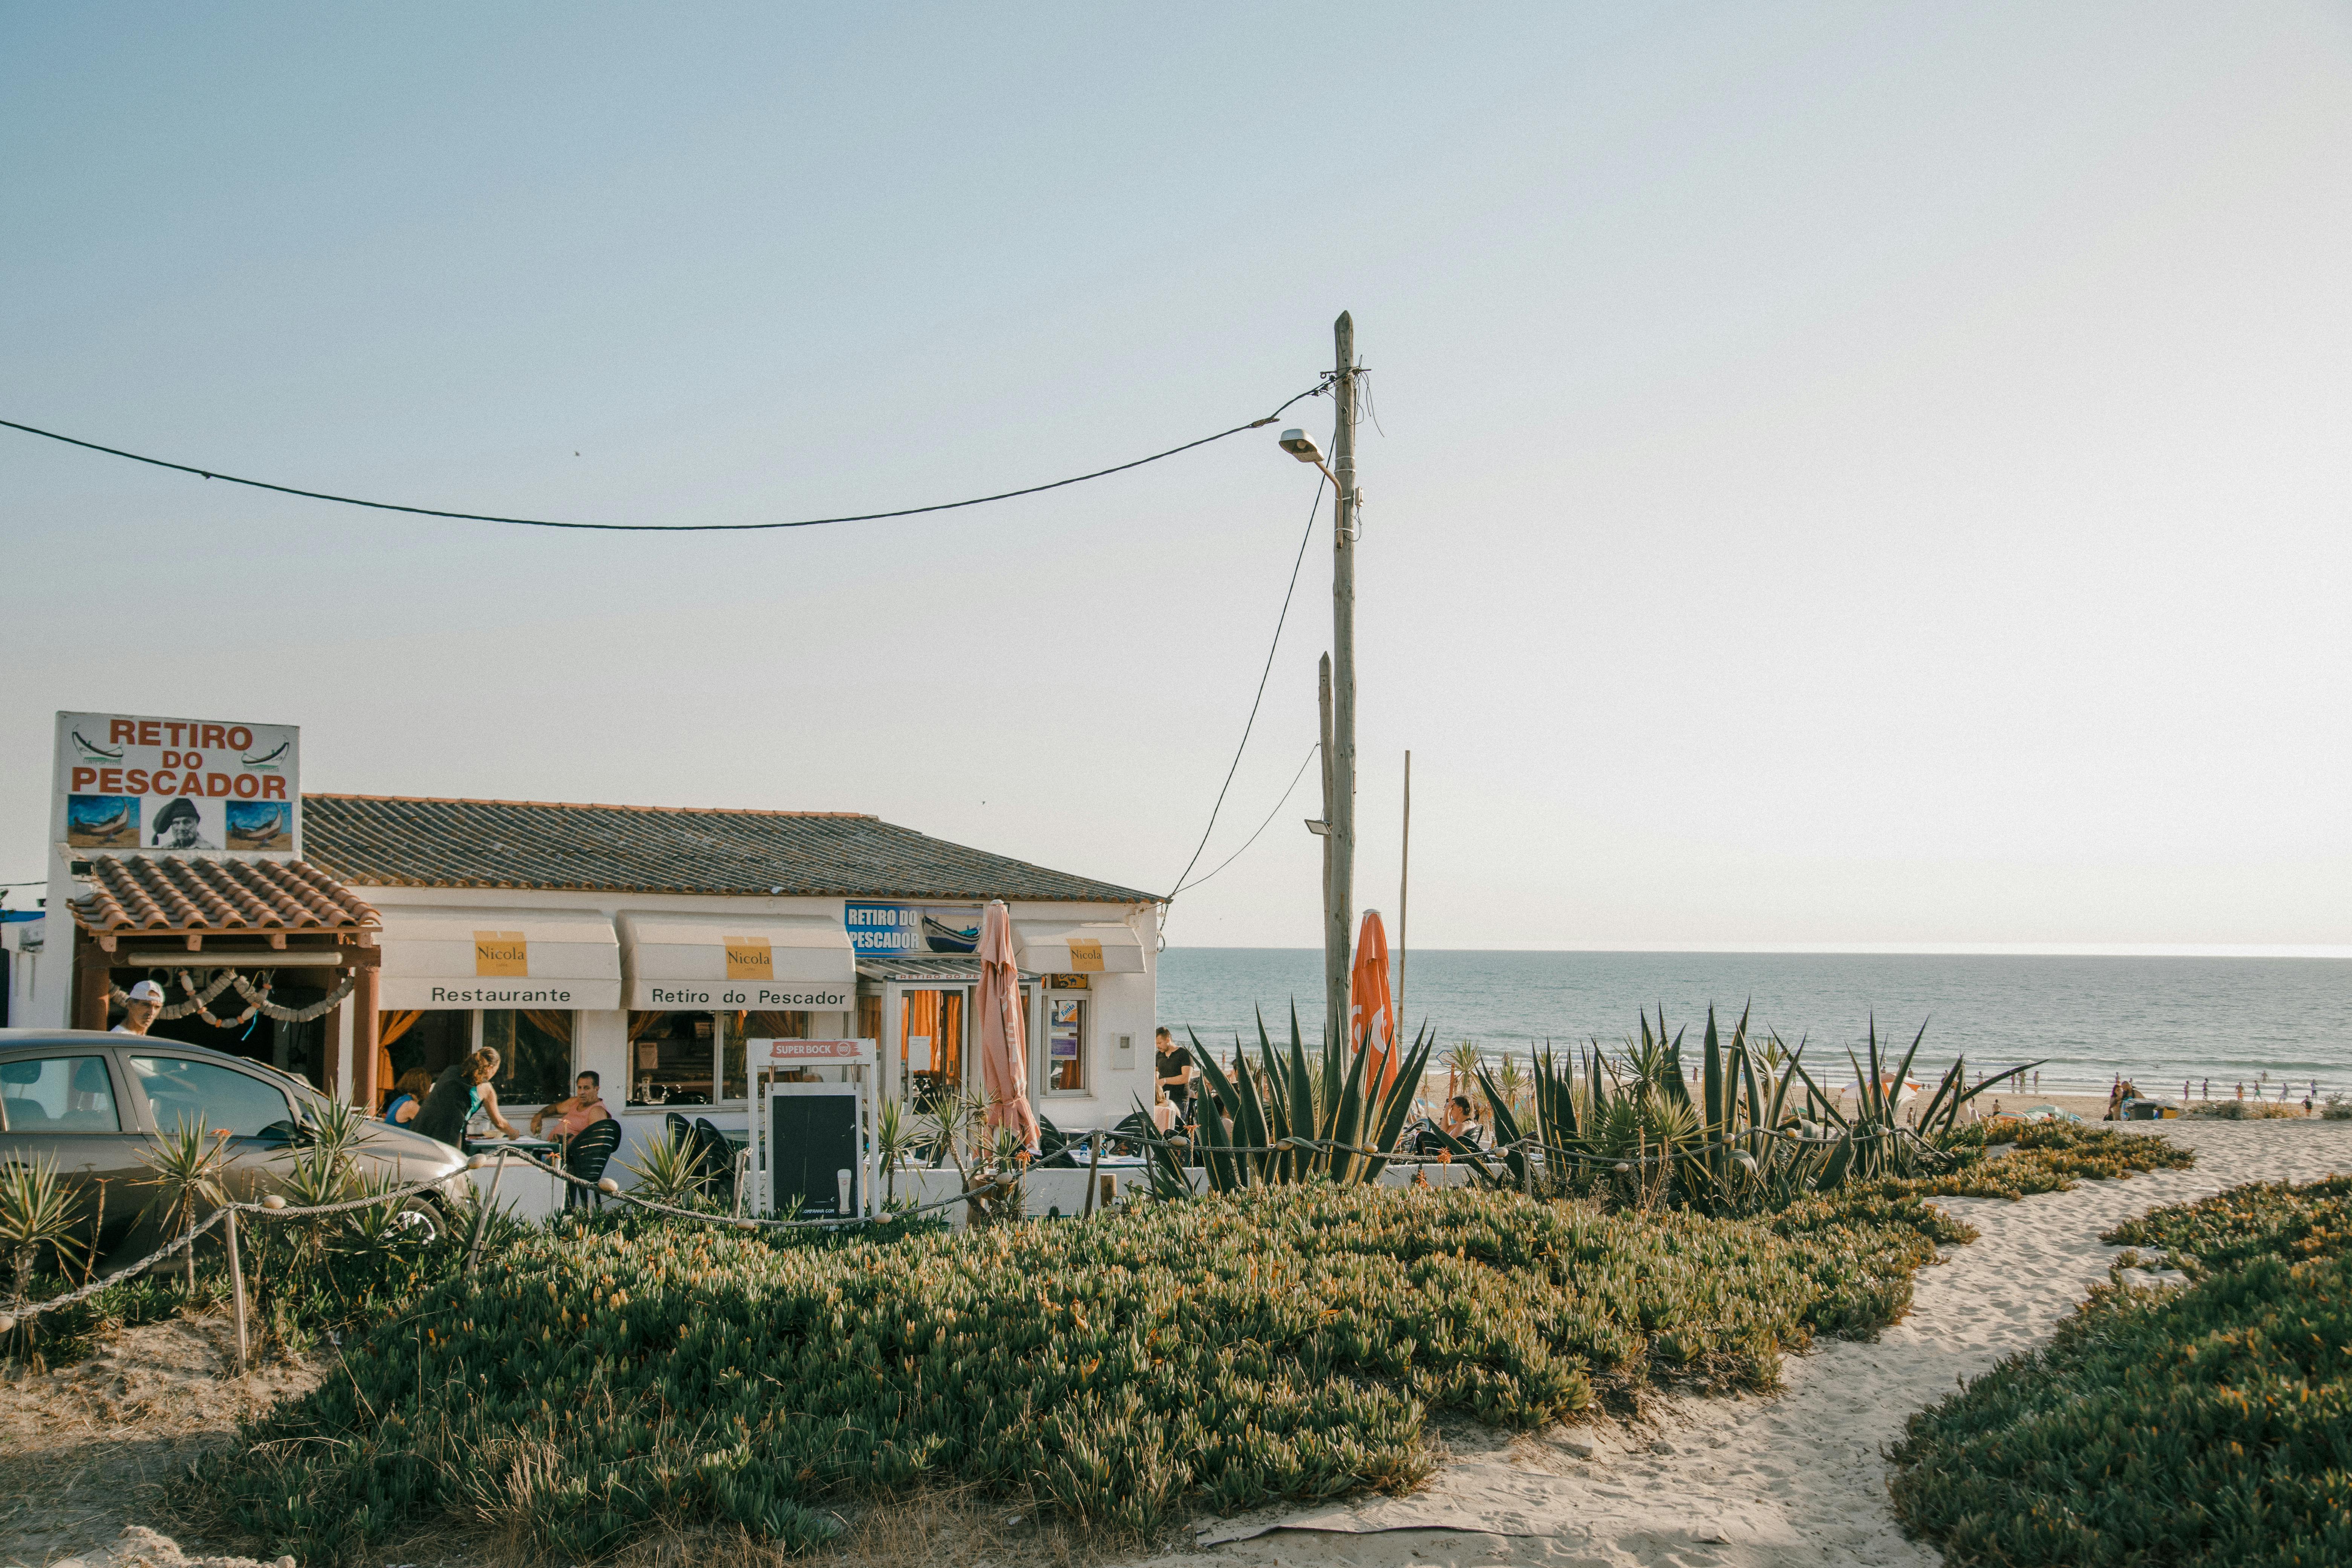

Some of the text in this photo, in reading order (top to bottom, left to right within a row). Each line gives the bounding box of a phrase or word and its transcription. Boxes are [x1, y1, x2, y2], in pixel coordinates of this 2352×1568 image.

[109, 719, 253, 751] RETIRO
[162, 751, 203, 770] DO
[72, 767, 286, 799] PESCADOR
[848, 909, 918, 926] RETIRO DO
[849, 931, 919, 949] PESCADOR
[478, 946, 524, 960] Nicola
[728, 951, 770, 964] Nicola
[1071, 949, 1101, 959] Nicola
[432, 988, 571, 1001] Restaurante
[652, 989, 846, 1004] Retiro do Pescador
[776, 1046, 804, 1054] SUPER
[806, 1045, 831, 1054] BOCK
